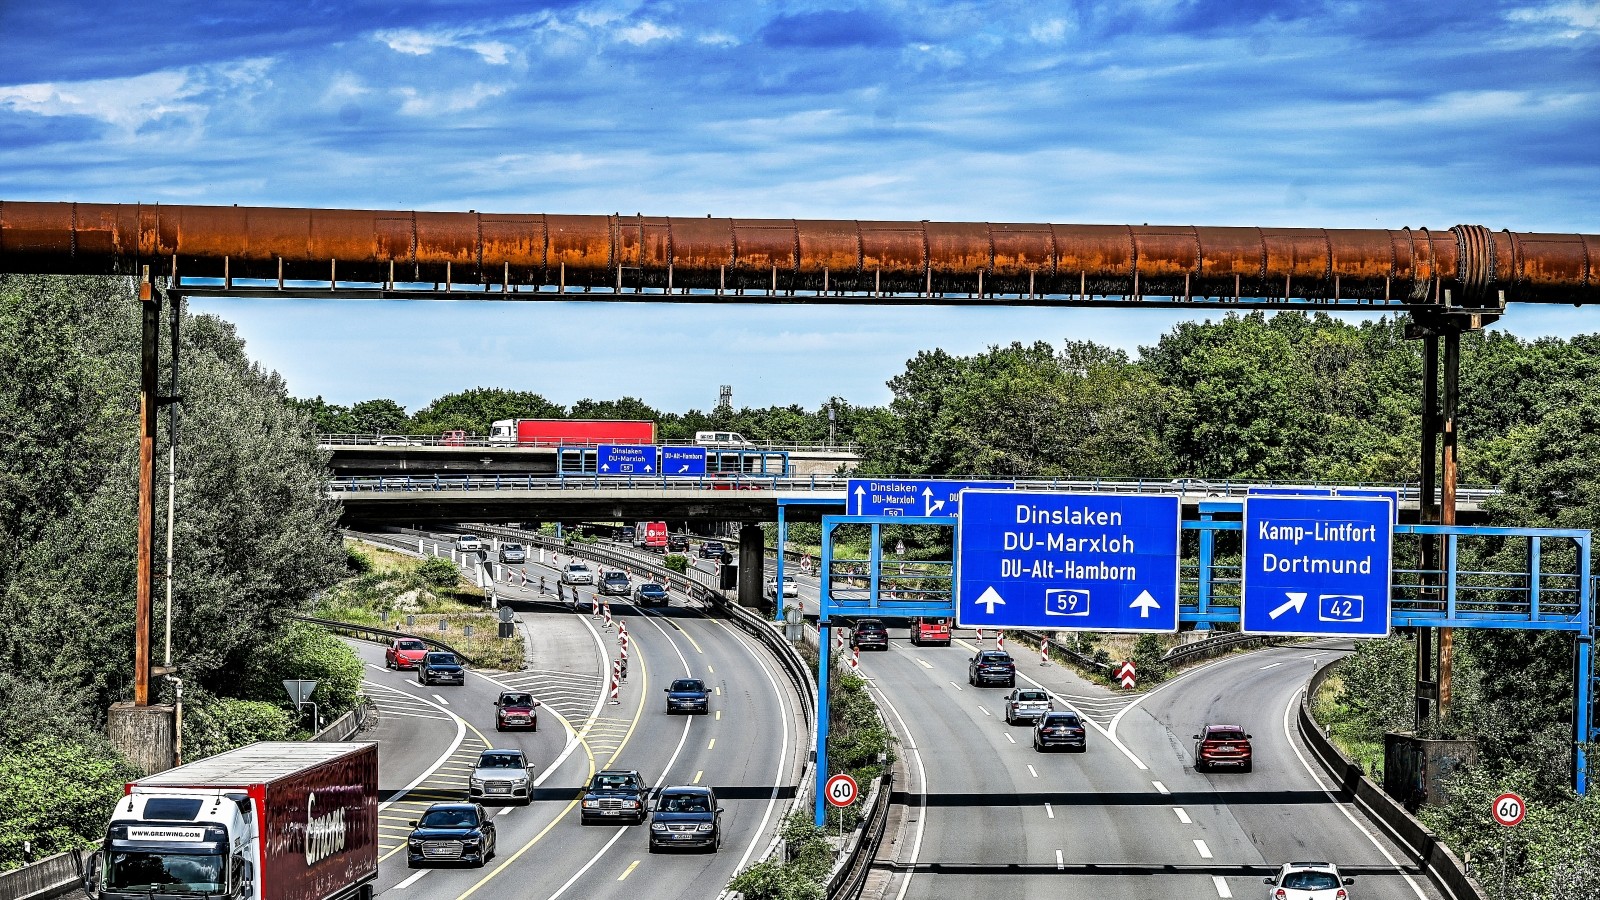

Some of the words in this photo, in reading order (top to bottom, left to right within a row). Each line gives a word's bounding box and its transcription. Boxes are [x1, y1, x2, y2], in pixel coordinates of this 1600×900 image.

[608, 455, 646, 463] DU-Marxloh
[664, 452, 703, 460] DU-Alt-Hamborn
[870, 482, 918, 492] Dinslaken
[872, 494, 915, 505] DU-Marxloh
[1016, 504, 1122, 526] Dinslaken
[1259, 520, 1376, 546] Kamp-Lintfort
[1004, 531, 1134, 554] DU-Marxloh
[1001, 558, 1136, 581] DU-Alt-Hamborn
[1263, 553, 1371, 574] Dortmund
[1057, 594, 1078, 611] 59
[1330, 600, 1352, 617] 42
[833, 783, 850, 798] 60
[1500, 801, 1518, 817] 60
[131, 830, 201, 838] WWW.GREIWING.COM
[305, 792, 347, 866] Emons
